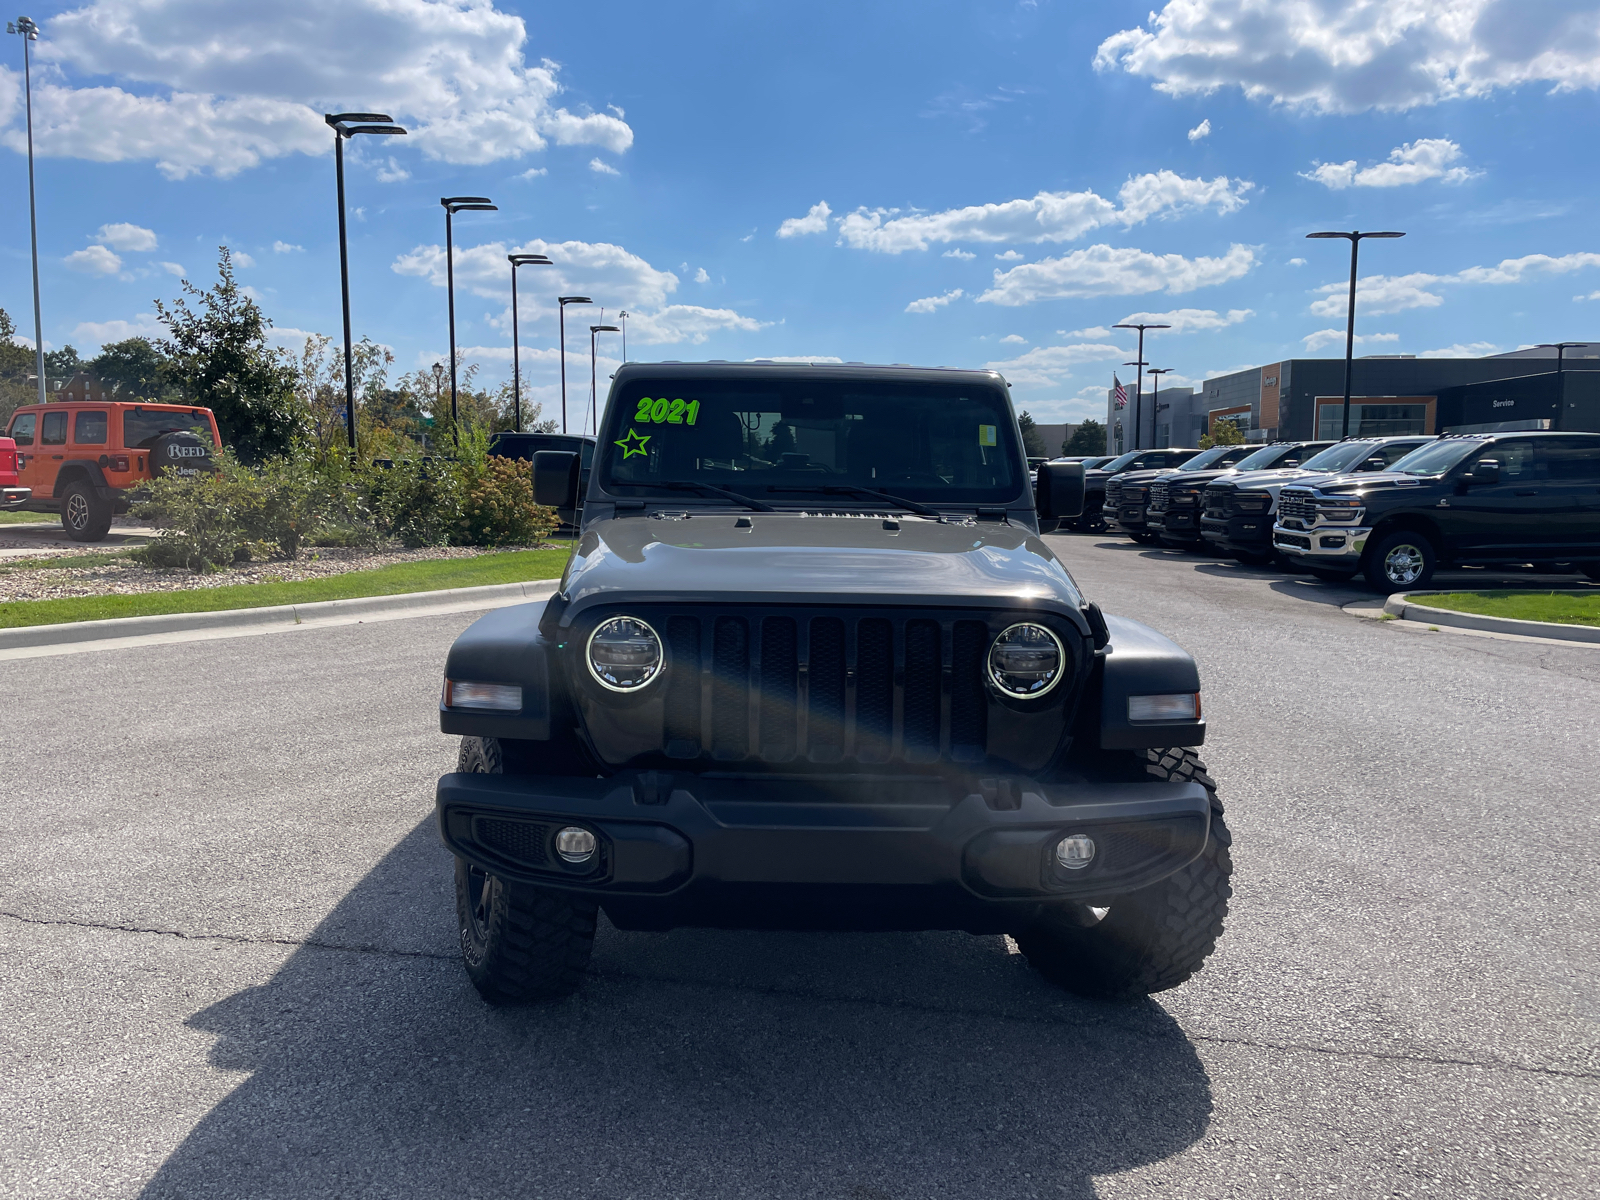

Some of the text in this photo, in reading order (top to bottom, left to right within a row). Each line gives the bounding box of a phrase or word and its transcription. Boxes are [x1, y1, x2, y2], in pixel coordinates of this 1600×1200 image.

[634, 397, 700, 426] 2021
[1492, 399, 1515, 408] Service
[167, 443, 205, 460] REED
